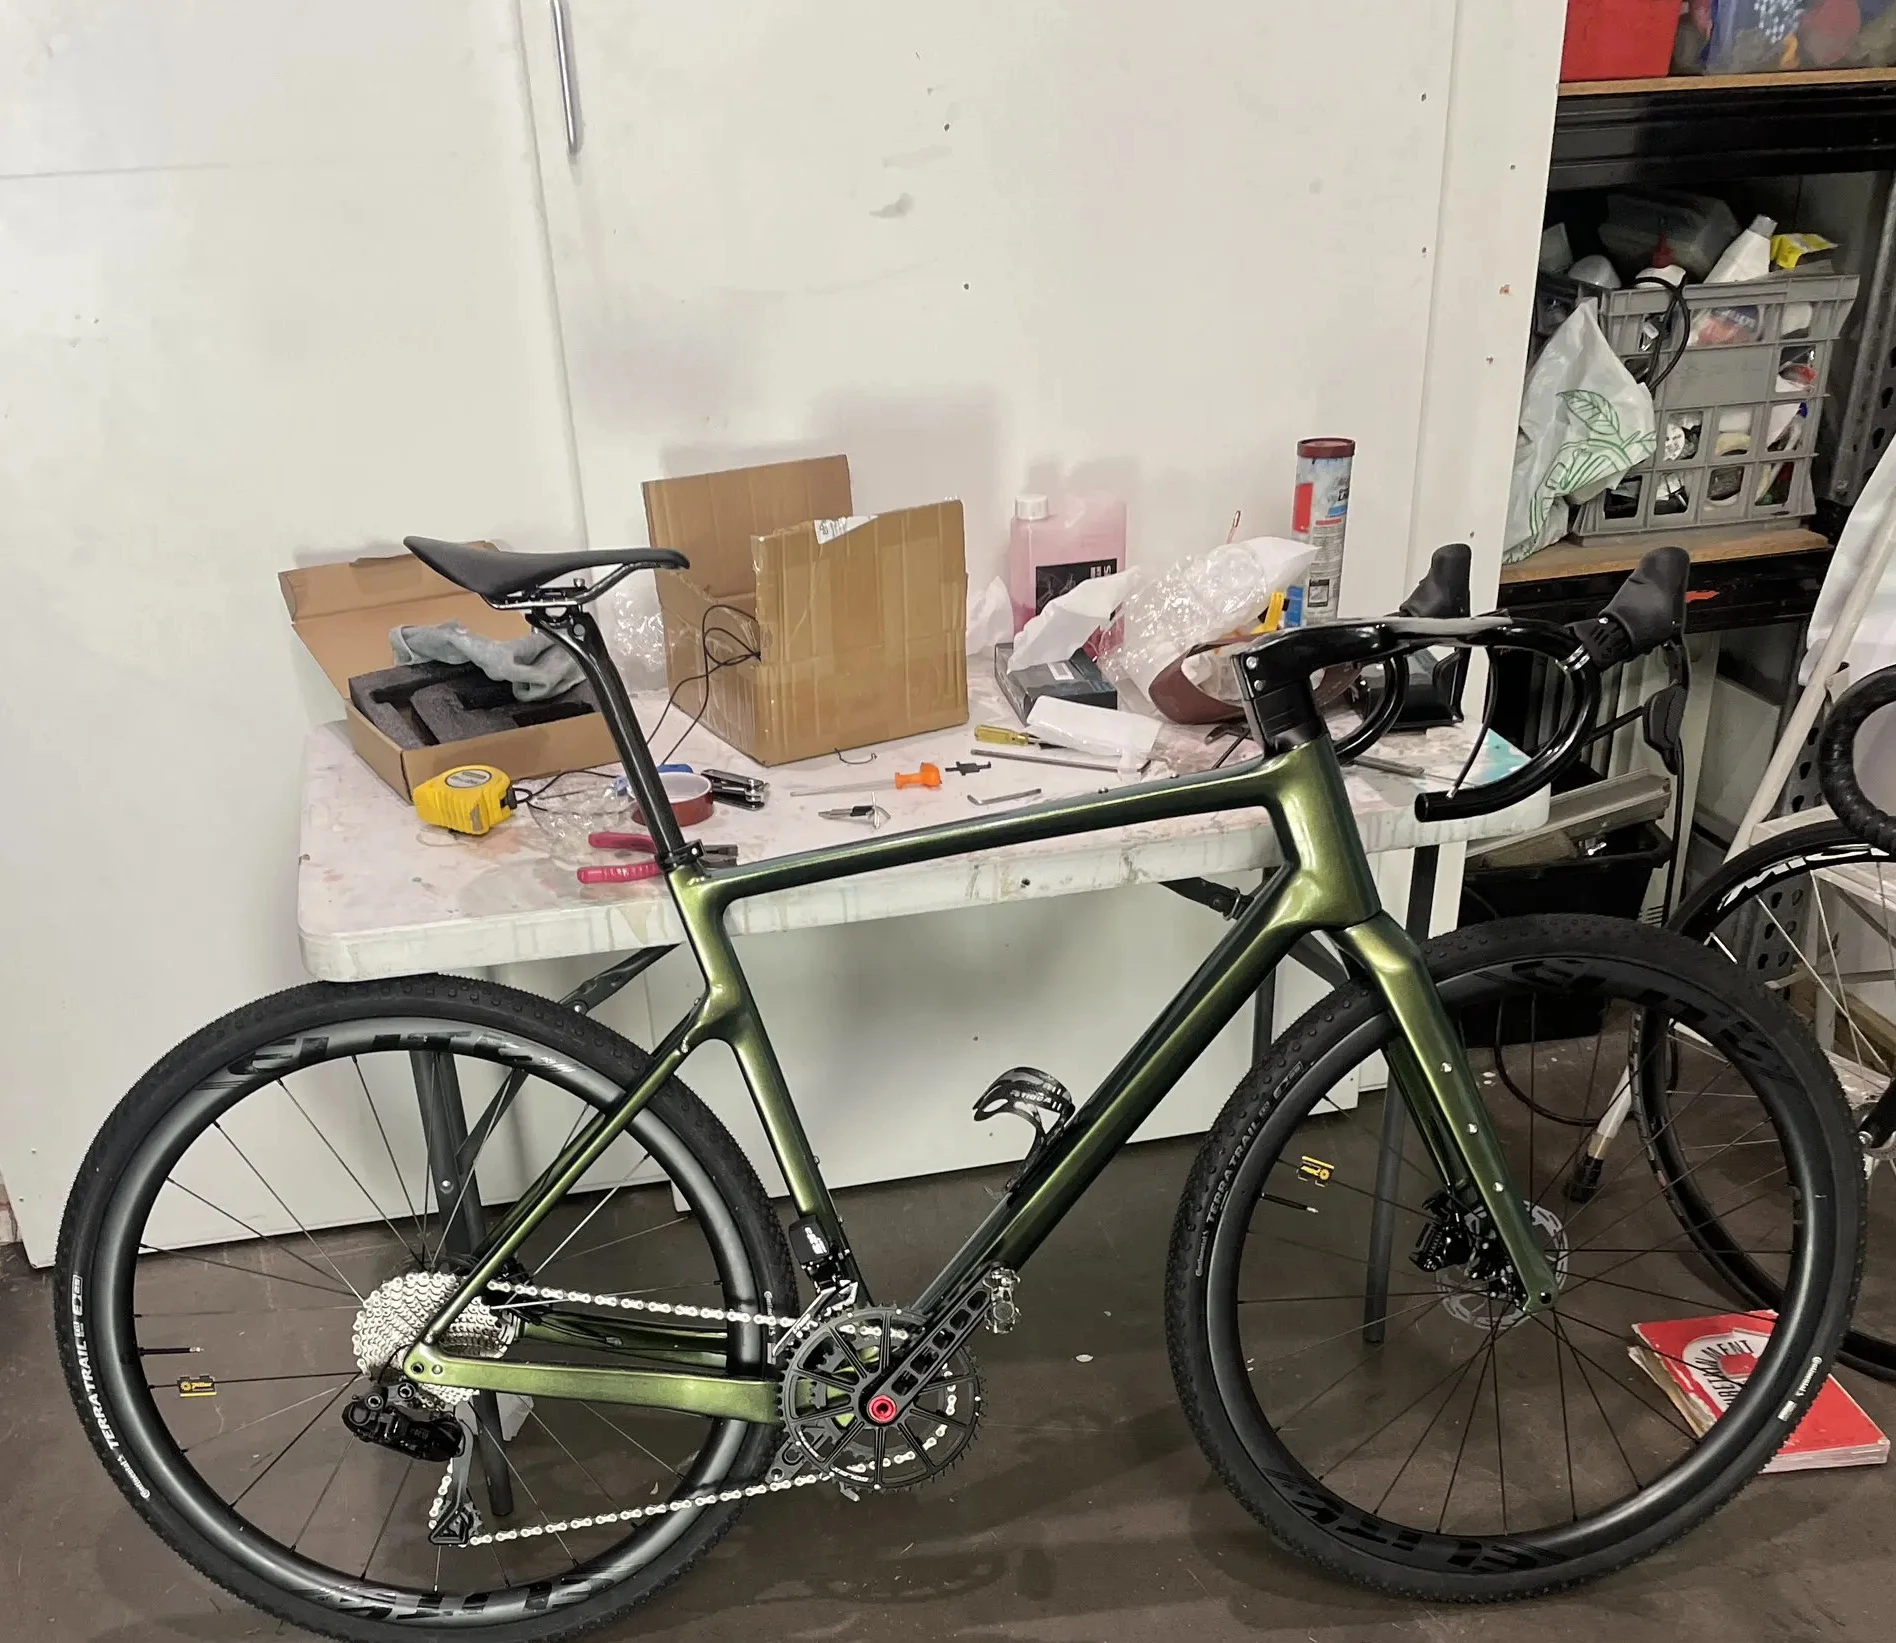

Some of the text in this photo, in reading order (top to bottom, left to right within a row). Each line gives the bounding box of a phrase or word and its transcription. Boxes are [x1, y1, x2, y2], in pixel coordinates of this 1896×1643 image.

[1206, 1170, 1235, 1224] TERRA
[1230, 1121, 1261, 1169] TRAIL
[76, 1341, 97, 1393] TRAIL
[87, 1393, 120, 1450] TERRA
